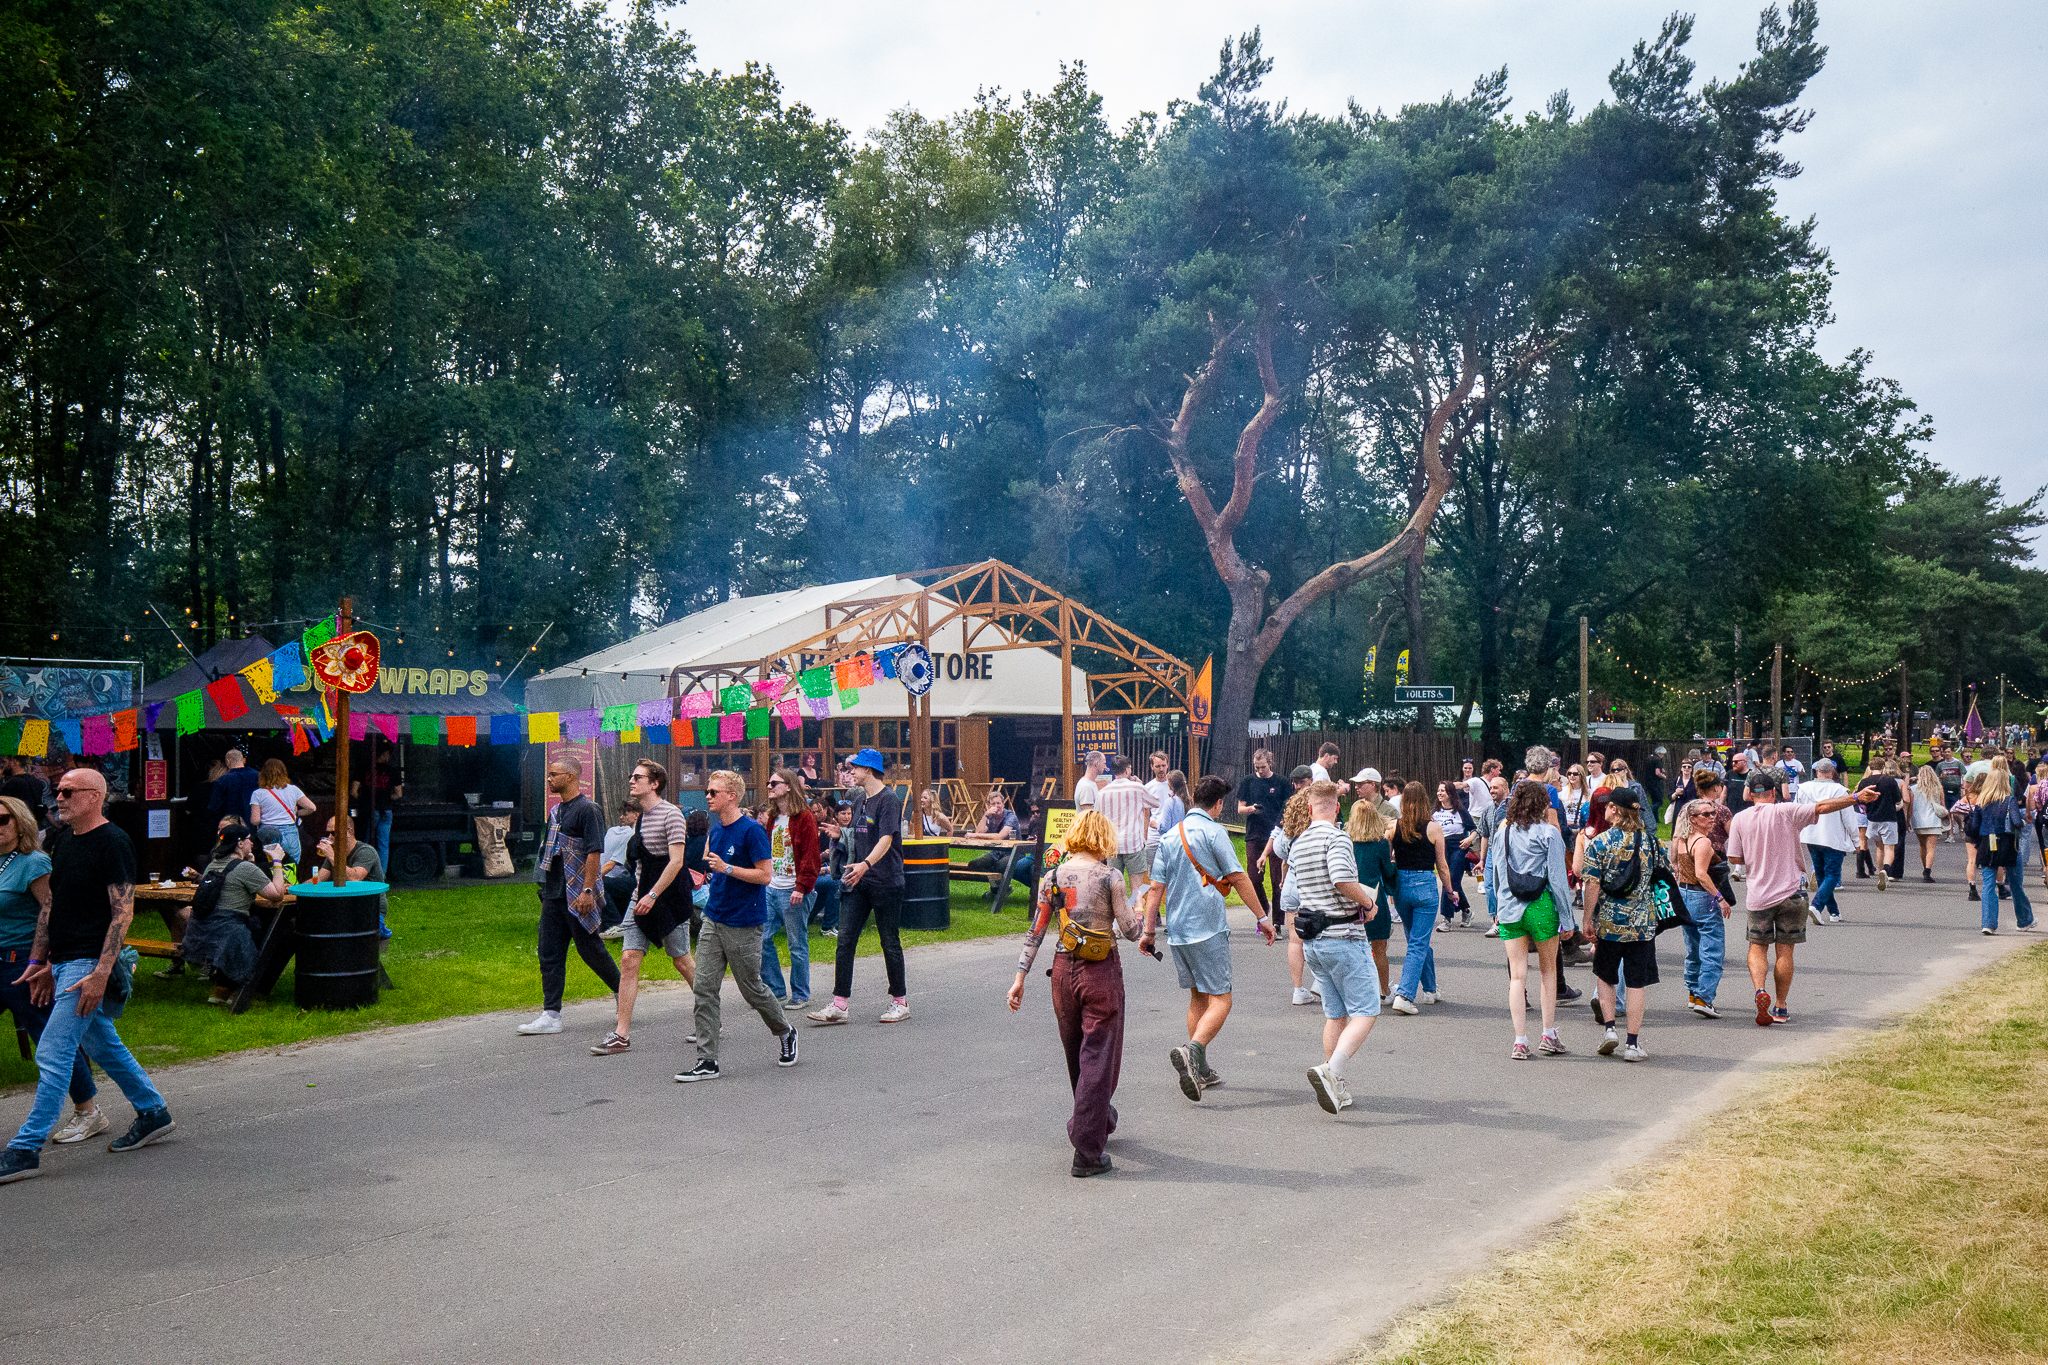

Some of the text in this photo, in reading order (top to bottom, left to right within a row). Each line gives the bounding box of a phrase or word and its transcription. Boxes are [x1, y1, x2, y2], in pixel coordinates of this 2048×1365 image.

[931, 652, 993, 681] TORE
[379, 667, 488, 696] WRAPS
[1405, 690, 1436, 699] TOILETS
[1077, 720, 1116, 731] SOUNDS
[1077, 732, 1116, 741] TILBURG
